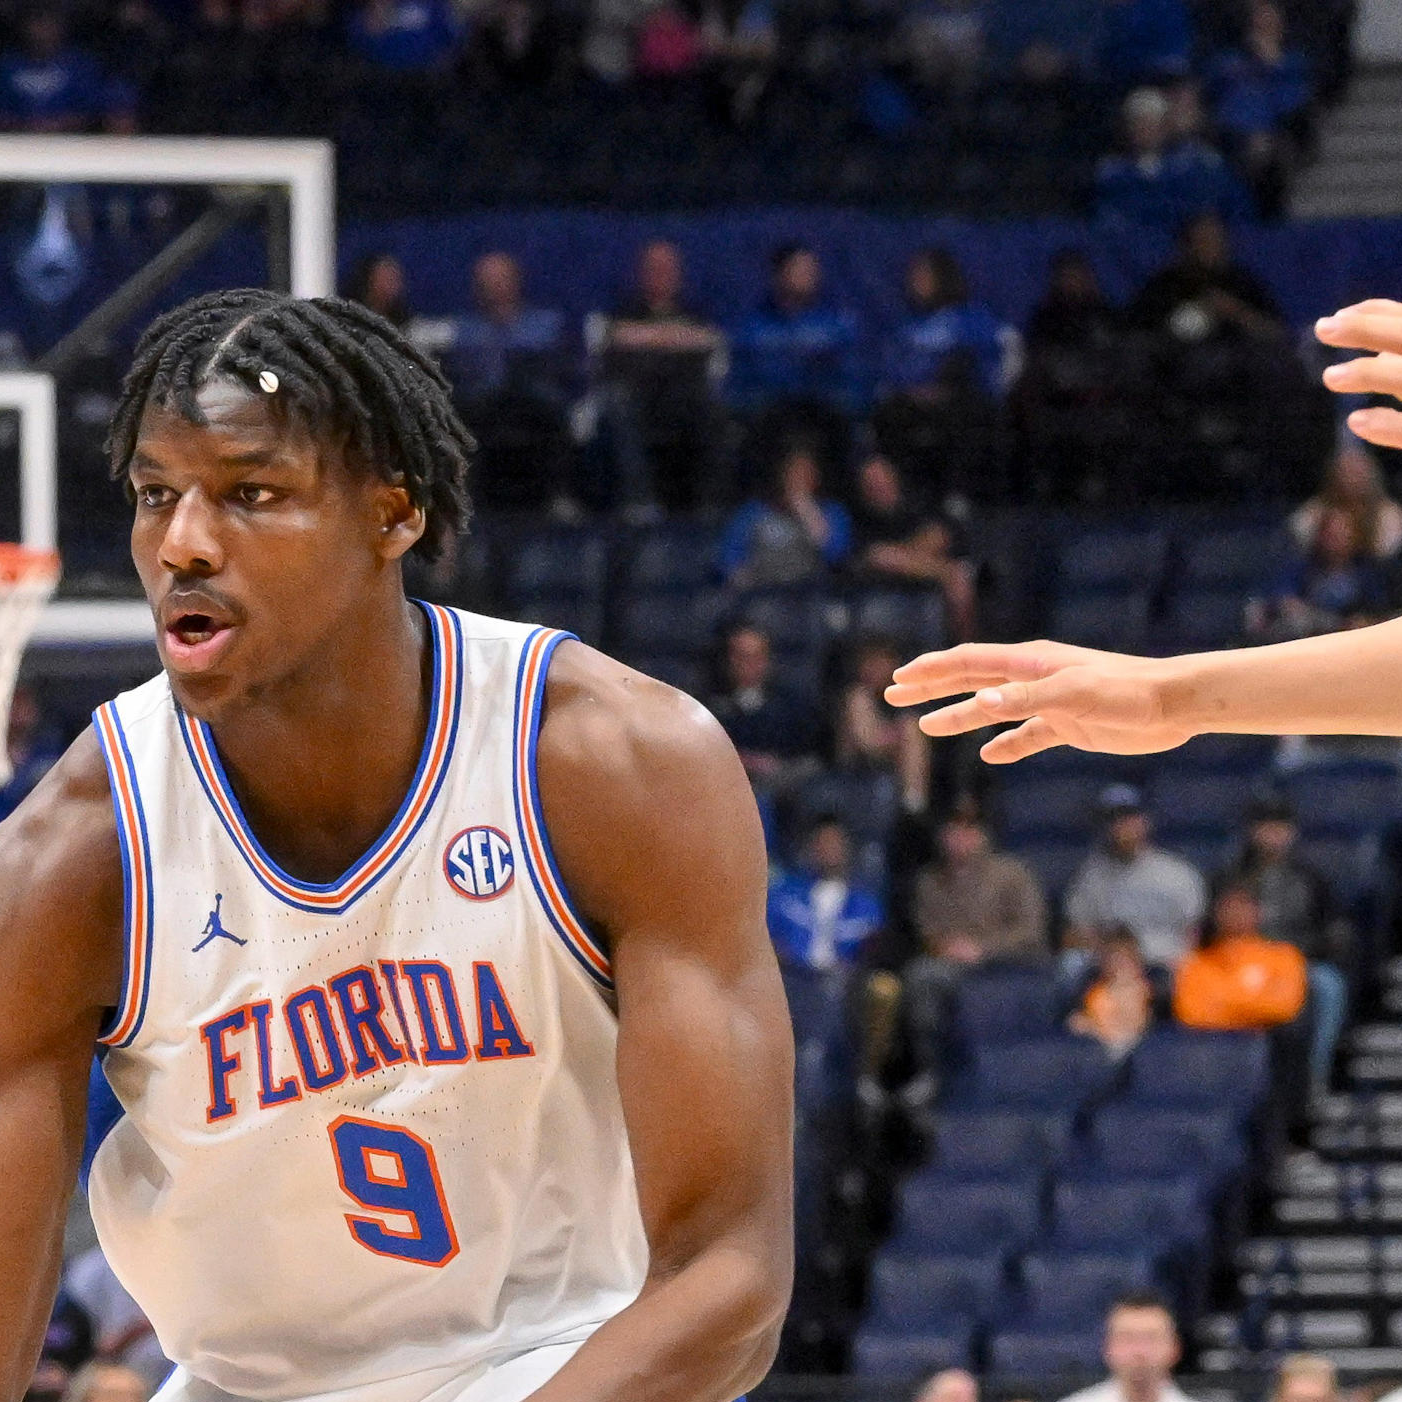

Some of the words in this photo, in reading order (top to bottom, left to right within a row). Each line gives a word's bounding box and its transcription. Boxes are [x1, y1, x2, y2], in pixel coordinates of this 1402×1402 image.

[449, 831, 512, 895] SEC
[199, 959, 536, 1124] FLORIDA
[327, 1114, 460, 1269] 9
